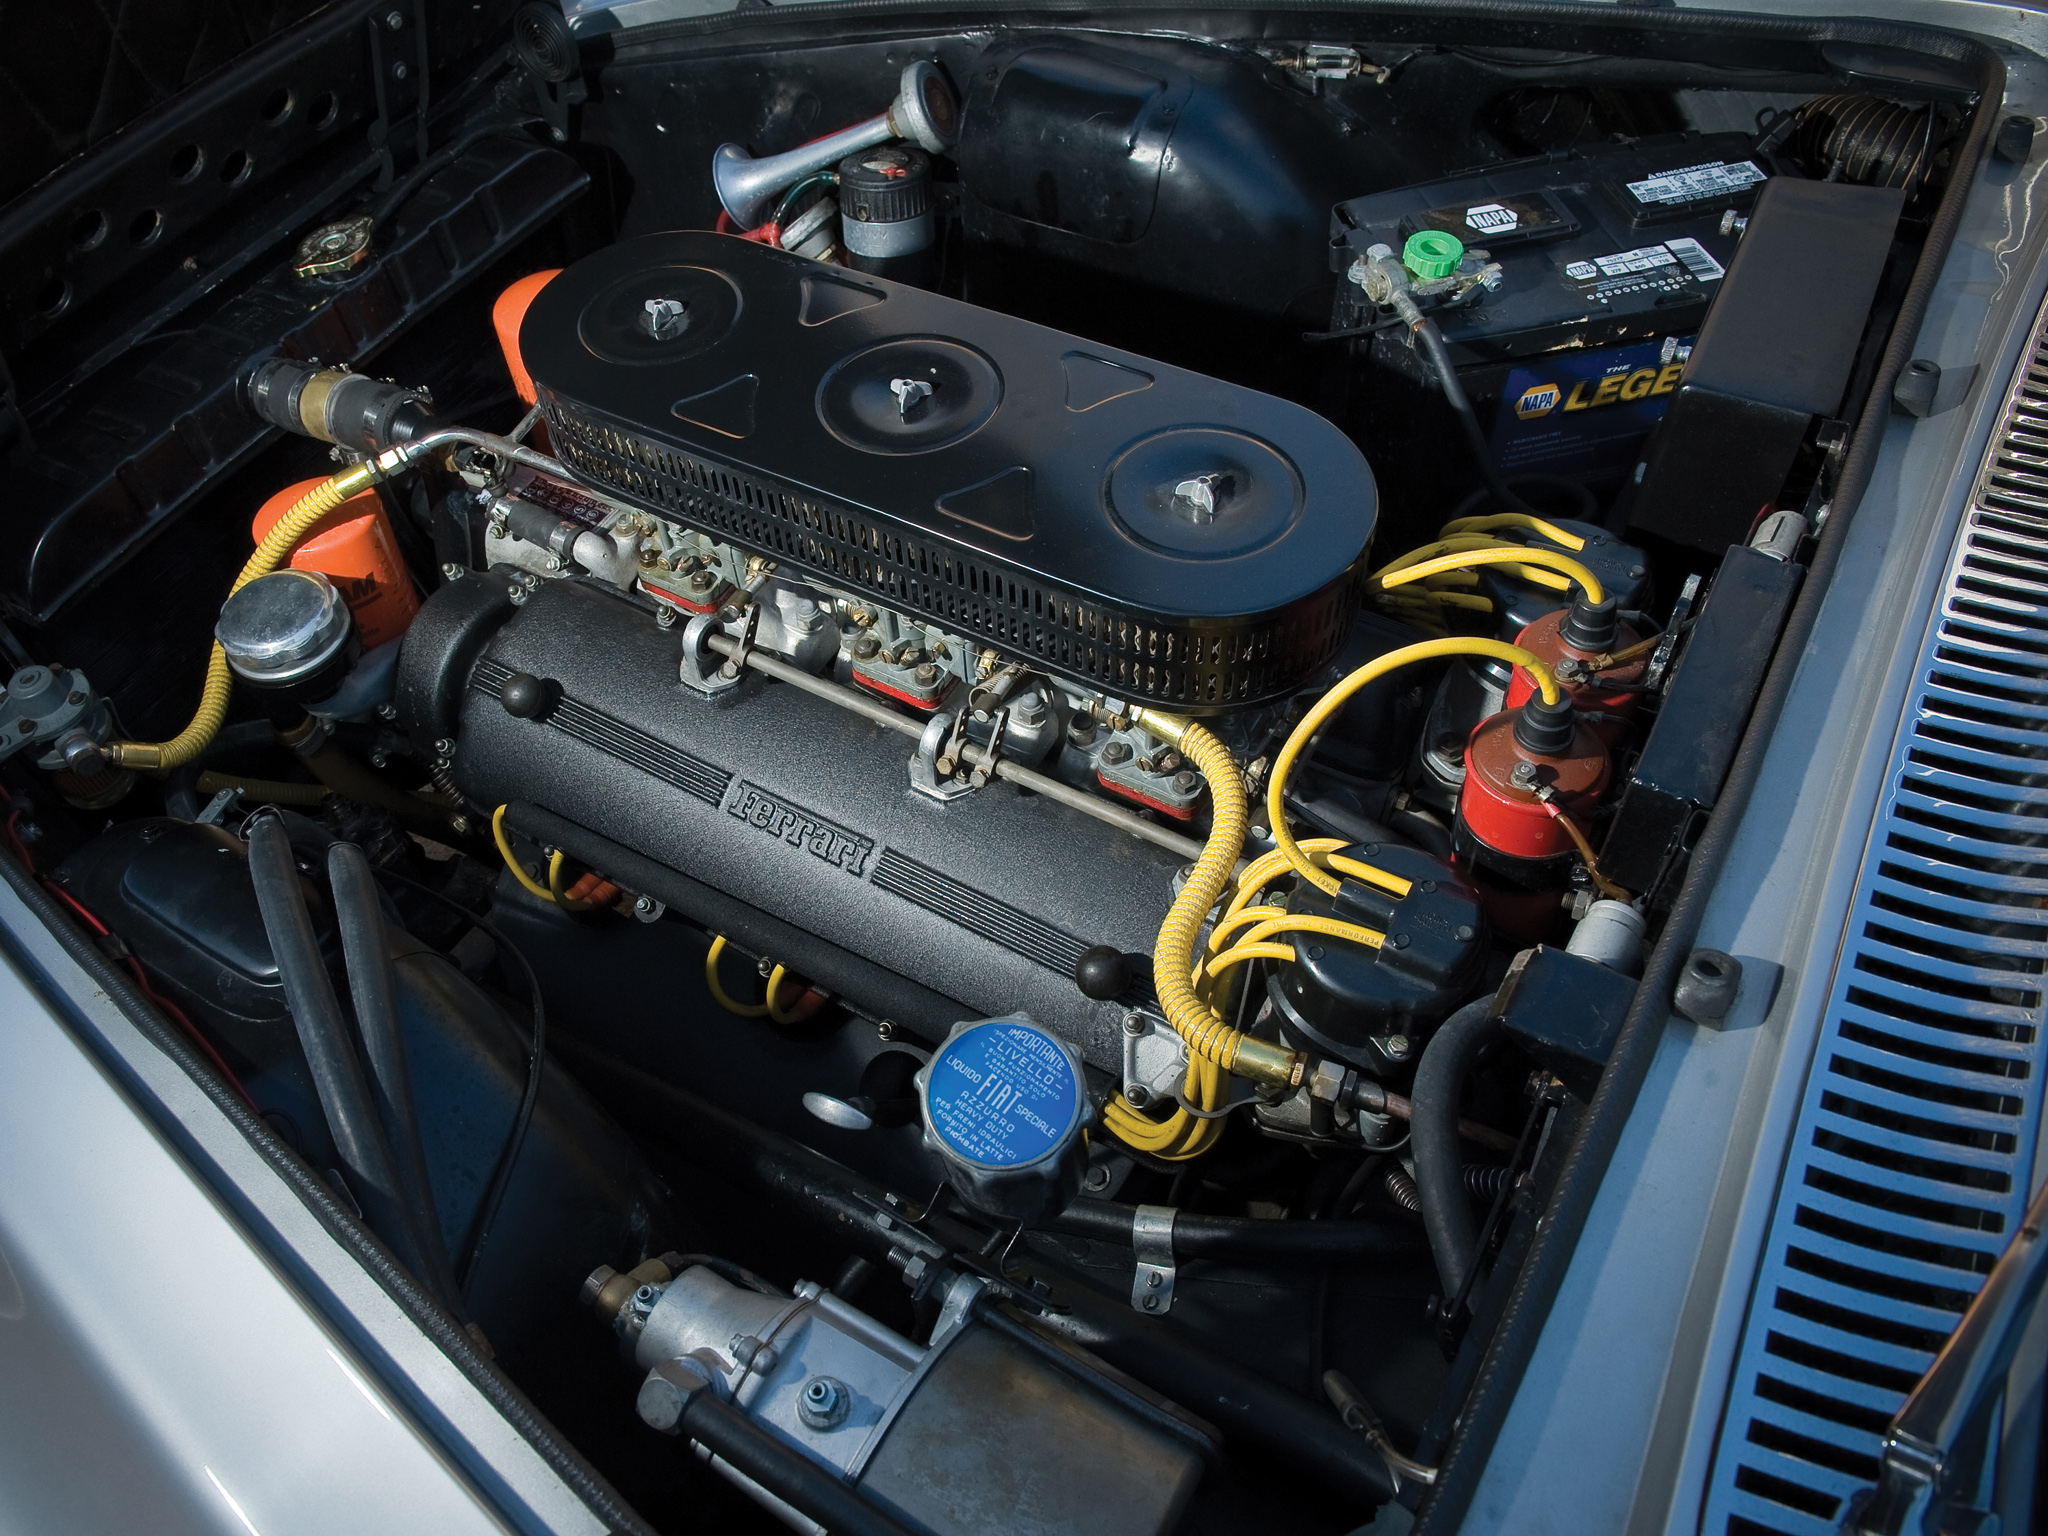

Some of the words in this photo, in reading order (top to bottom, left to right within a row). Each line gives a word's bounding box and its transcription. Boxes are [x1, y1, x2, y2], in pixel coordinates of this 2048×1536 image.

[1470, 209, 1513, 229] NAPA
[1568, 262, 1596, 278] NAPA
[1606, 364, 1631, 373] THE
[1520, 391, 1554, 412] NAPA
[728, 780, 875, 878] Ferrari
[1319, 923, 1380, 946] PERFORMANCE
[997, 1041, 1055, 1085] LIVELLO
[1008, 1028, 1066, 1071] IMPORTANTE
[985, 1061, 1014, 1084] FACENDO
[1016, 1083, 1029, 1095] USO
[988, 1047, 1007, 1062] BUON
[1008, 1061, 1061, 1101] FUNZIONAMENTO
[991, 1058, 1027, 1085] GARANTITO
[1028, 1084, 1046, 1099] SOLO
[946, 1054, 982, 1084] LIQUIDO
[976, 1073, 1023, 1115] FIAT
[1014, 1104, 1057, 1139] SPECIALE
[960, 1090, 1016, 1133] AZZURRO
[935, 1096, 951, 1111] PER
[951, 1109, 976, 1129] FRENI
[978, 1128, 1017, 1160] IDRAULICI
[936, 1108, 969, 1134] FORNITO
[970, 1133, 979, 1142] IN
[980, 1140, 1004, 1161] LATTE
[954, 1098, 985, 1122] HEAVY
[985, 1120, 1010, 1140] DUTY
[944, 1125, 985, 1159] PIOMBATE
